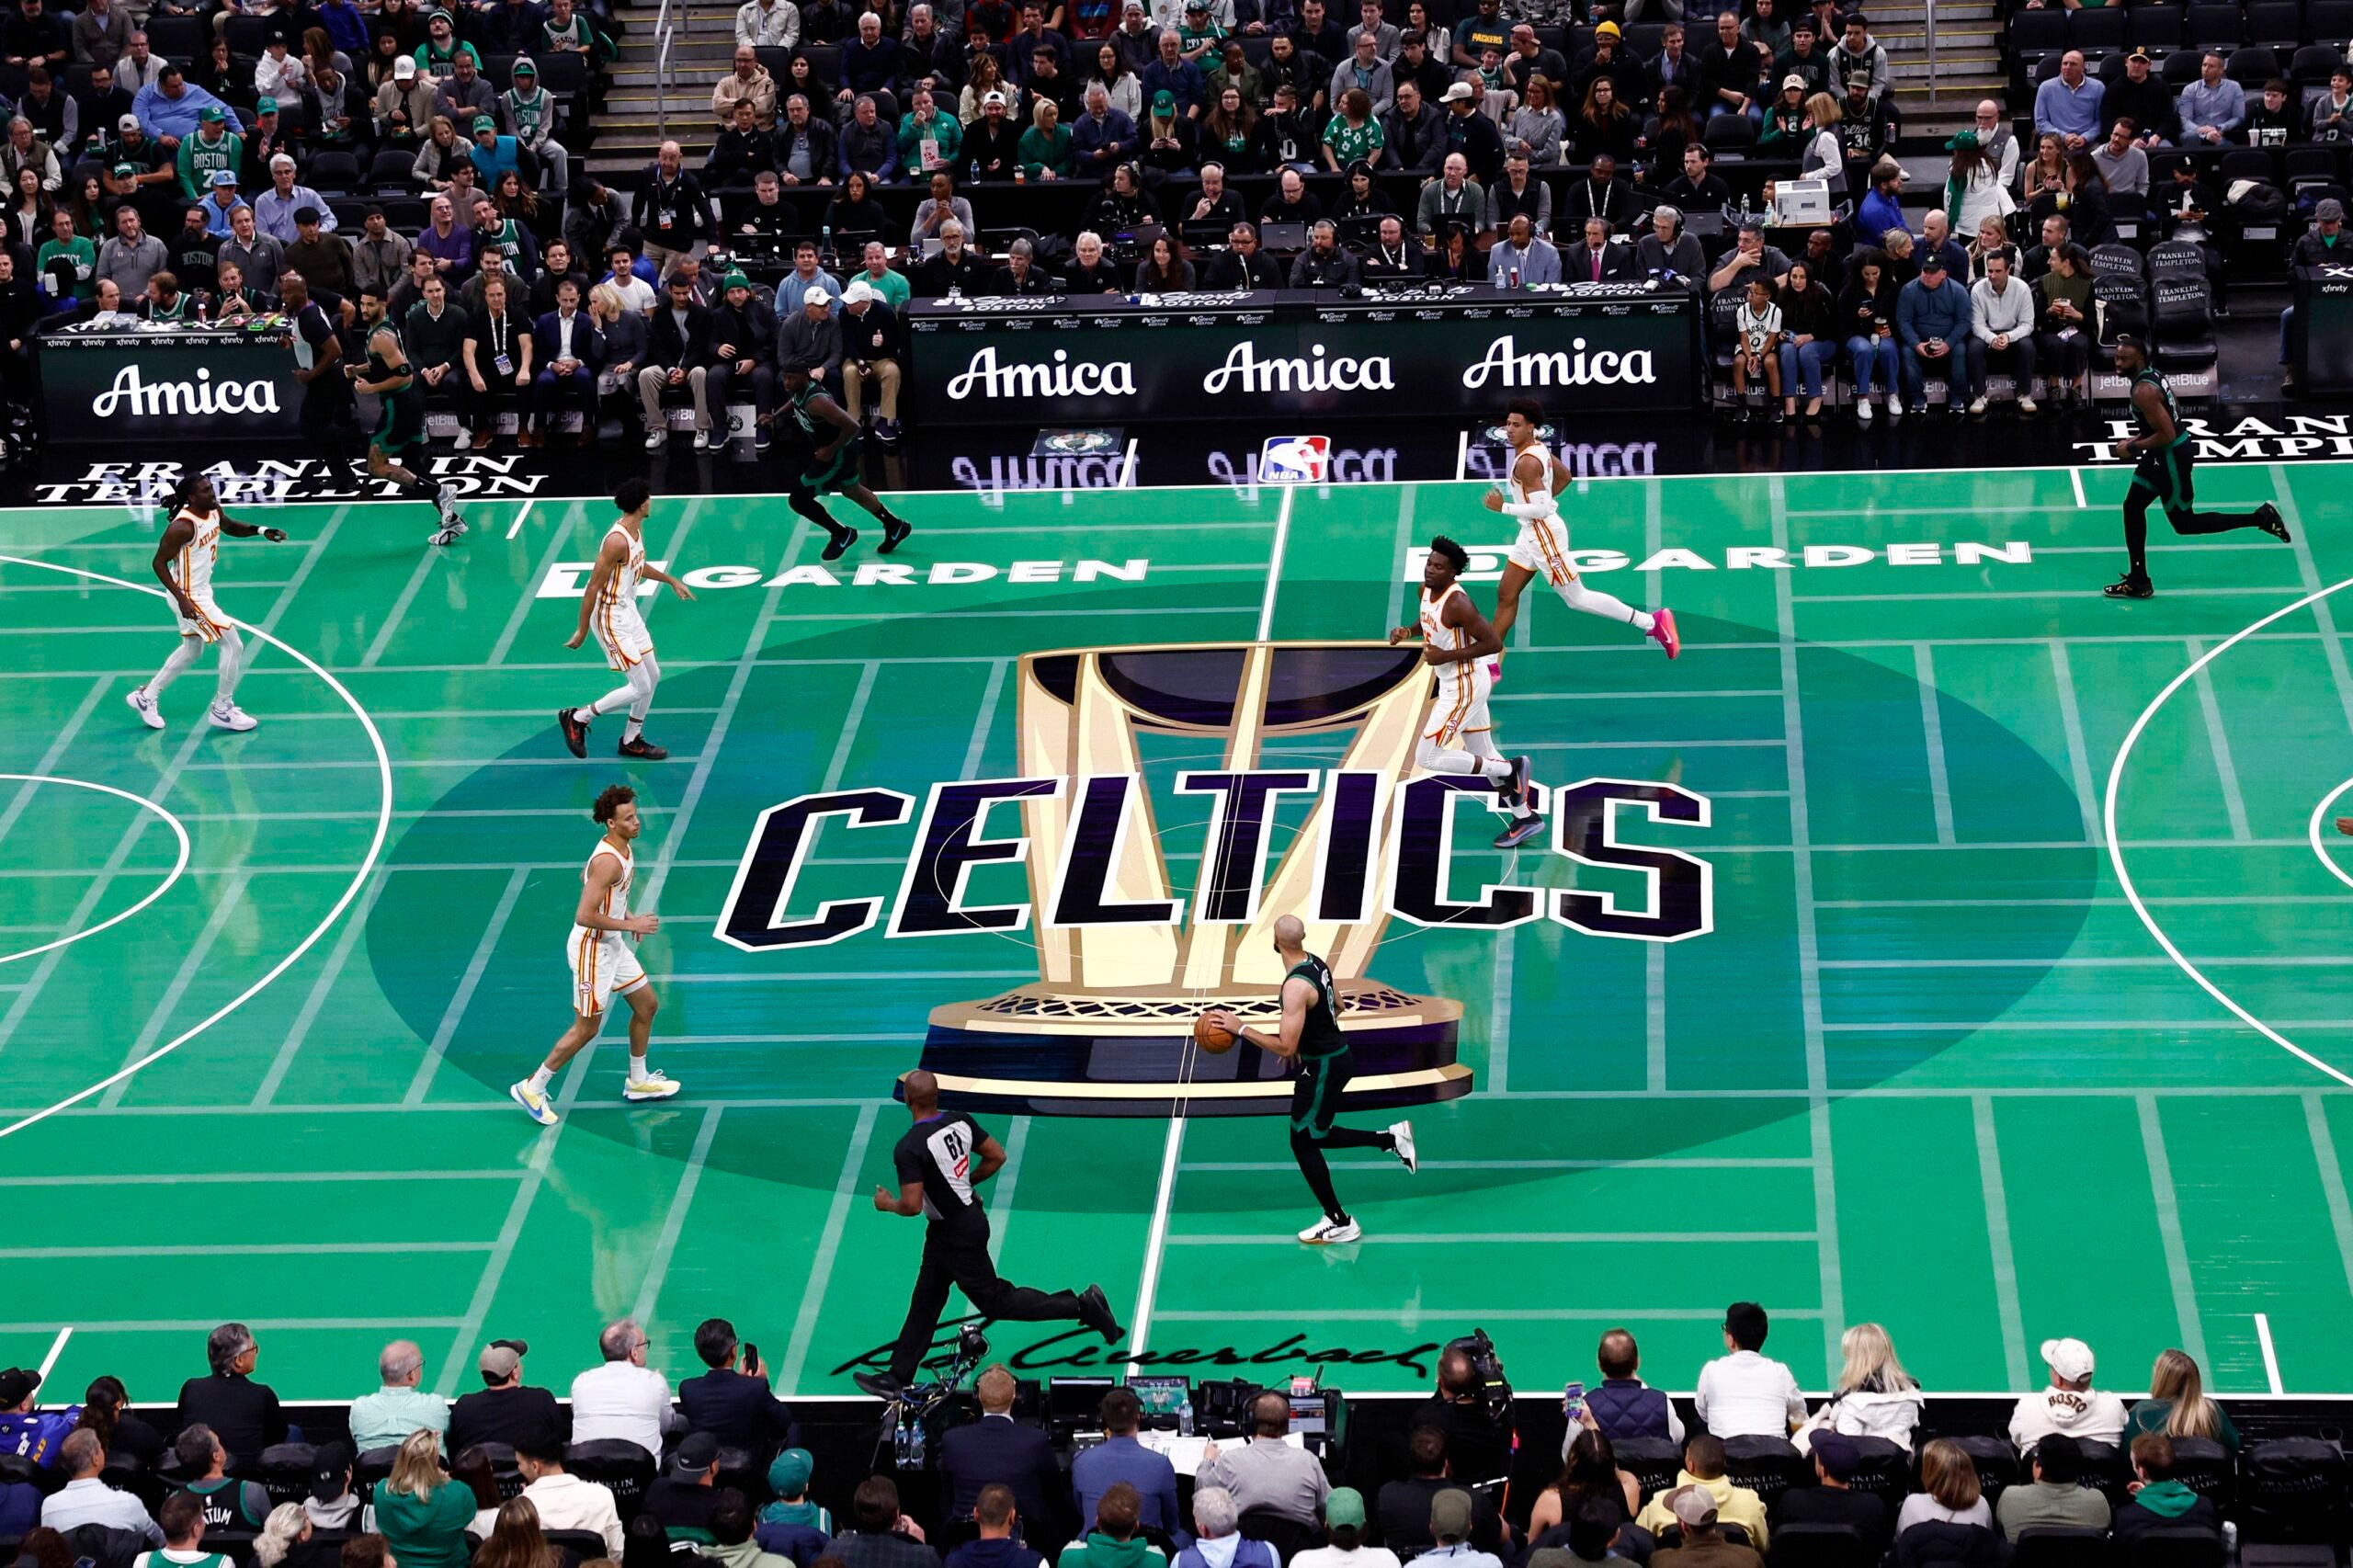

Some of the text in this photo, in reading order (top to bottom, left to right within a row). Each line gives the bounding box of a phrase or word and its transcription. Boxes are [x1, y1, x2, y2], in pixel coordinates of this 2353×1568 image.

[1471, 32, 1504, 45] PACKERS
[193, 152, 227, 169] BOSTON
[501, 241, 520, 256] TON
[2094, 253, 2132, 265] FRANKLIN
[2157, 251, 2196, 260] FRANKLIN
[2155, 258, 2201, 267] TEMPLETON.
[2095, 286, 2133, 294] FRANKLIN
[2159, 284, 2199, 296] FRANKLIN
[2322, 284, 2347, 293] xfinity
[1160, 291, 1254, 302] Sports
[1717, 296, 1746, 304] FRANKL
[2101, 293, 2140, 301] MPLETON.
[2158, 291, 2205, 303] TEMPLETON.
[47, 339, 71, 347] xfinity
[116, 338, 140, 347] xfinity
[255, 335, 278, 344] xfinity
[1751, 336, 1760, 347] 0
[1203, 341, 1395, 394] Amica
[1462, 335, 1656, 389] Amica
[947, 347, 1137, 400] Amica
[92, 364, 280, 417] Amica
[1268, 471, 1299, 480] NBA
[199, 526, 221, 549] ATLANT
[1567, 540, 2032, 574] GARDEN
[682, 559, 1148, 589] GARDEN
[712, 768, 1714, 953] CELTICS
[943, 1131, 964, 1161] 61
[1729, 1473, 1783, 1484] RANKLIN
[203, 1506, 233, 1526] TUM
